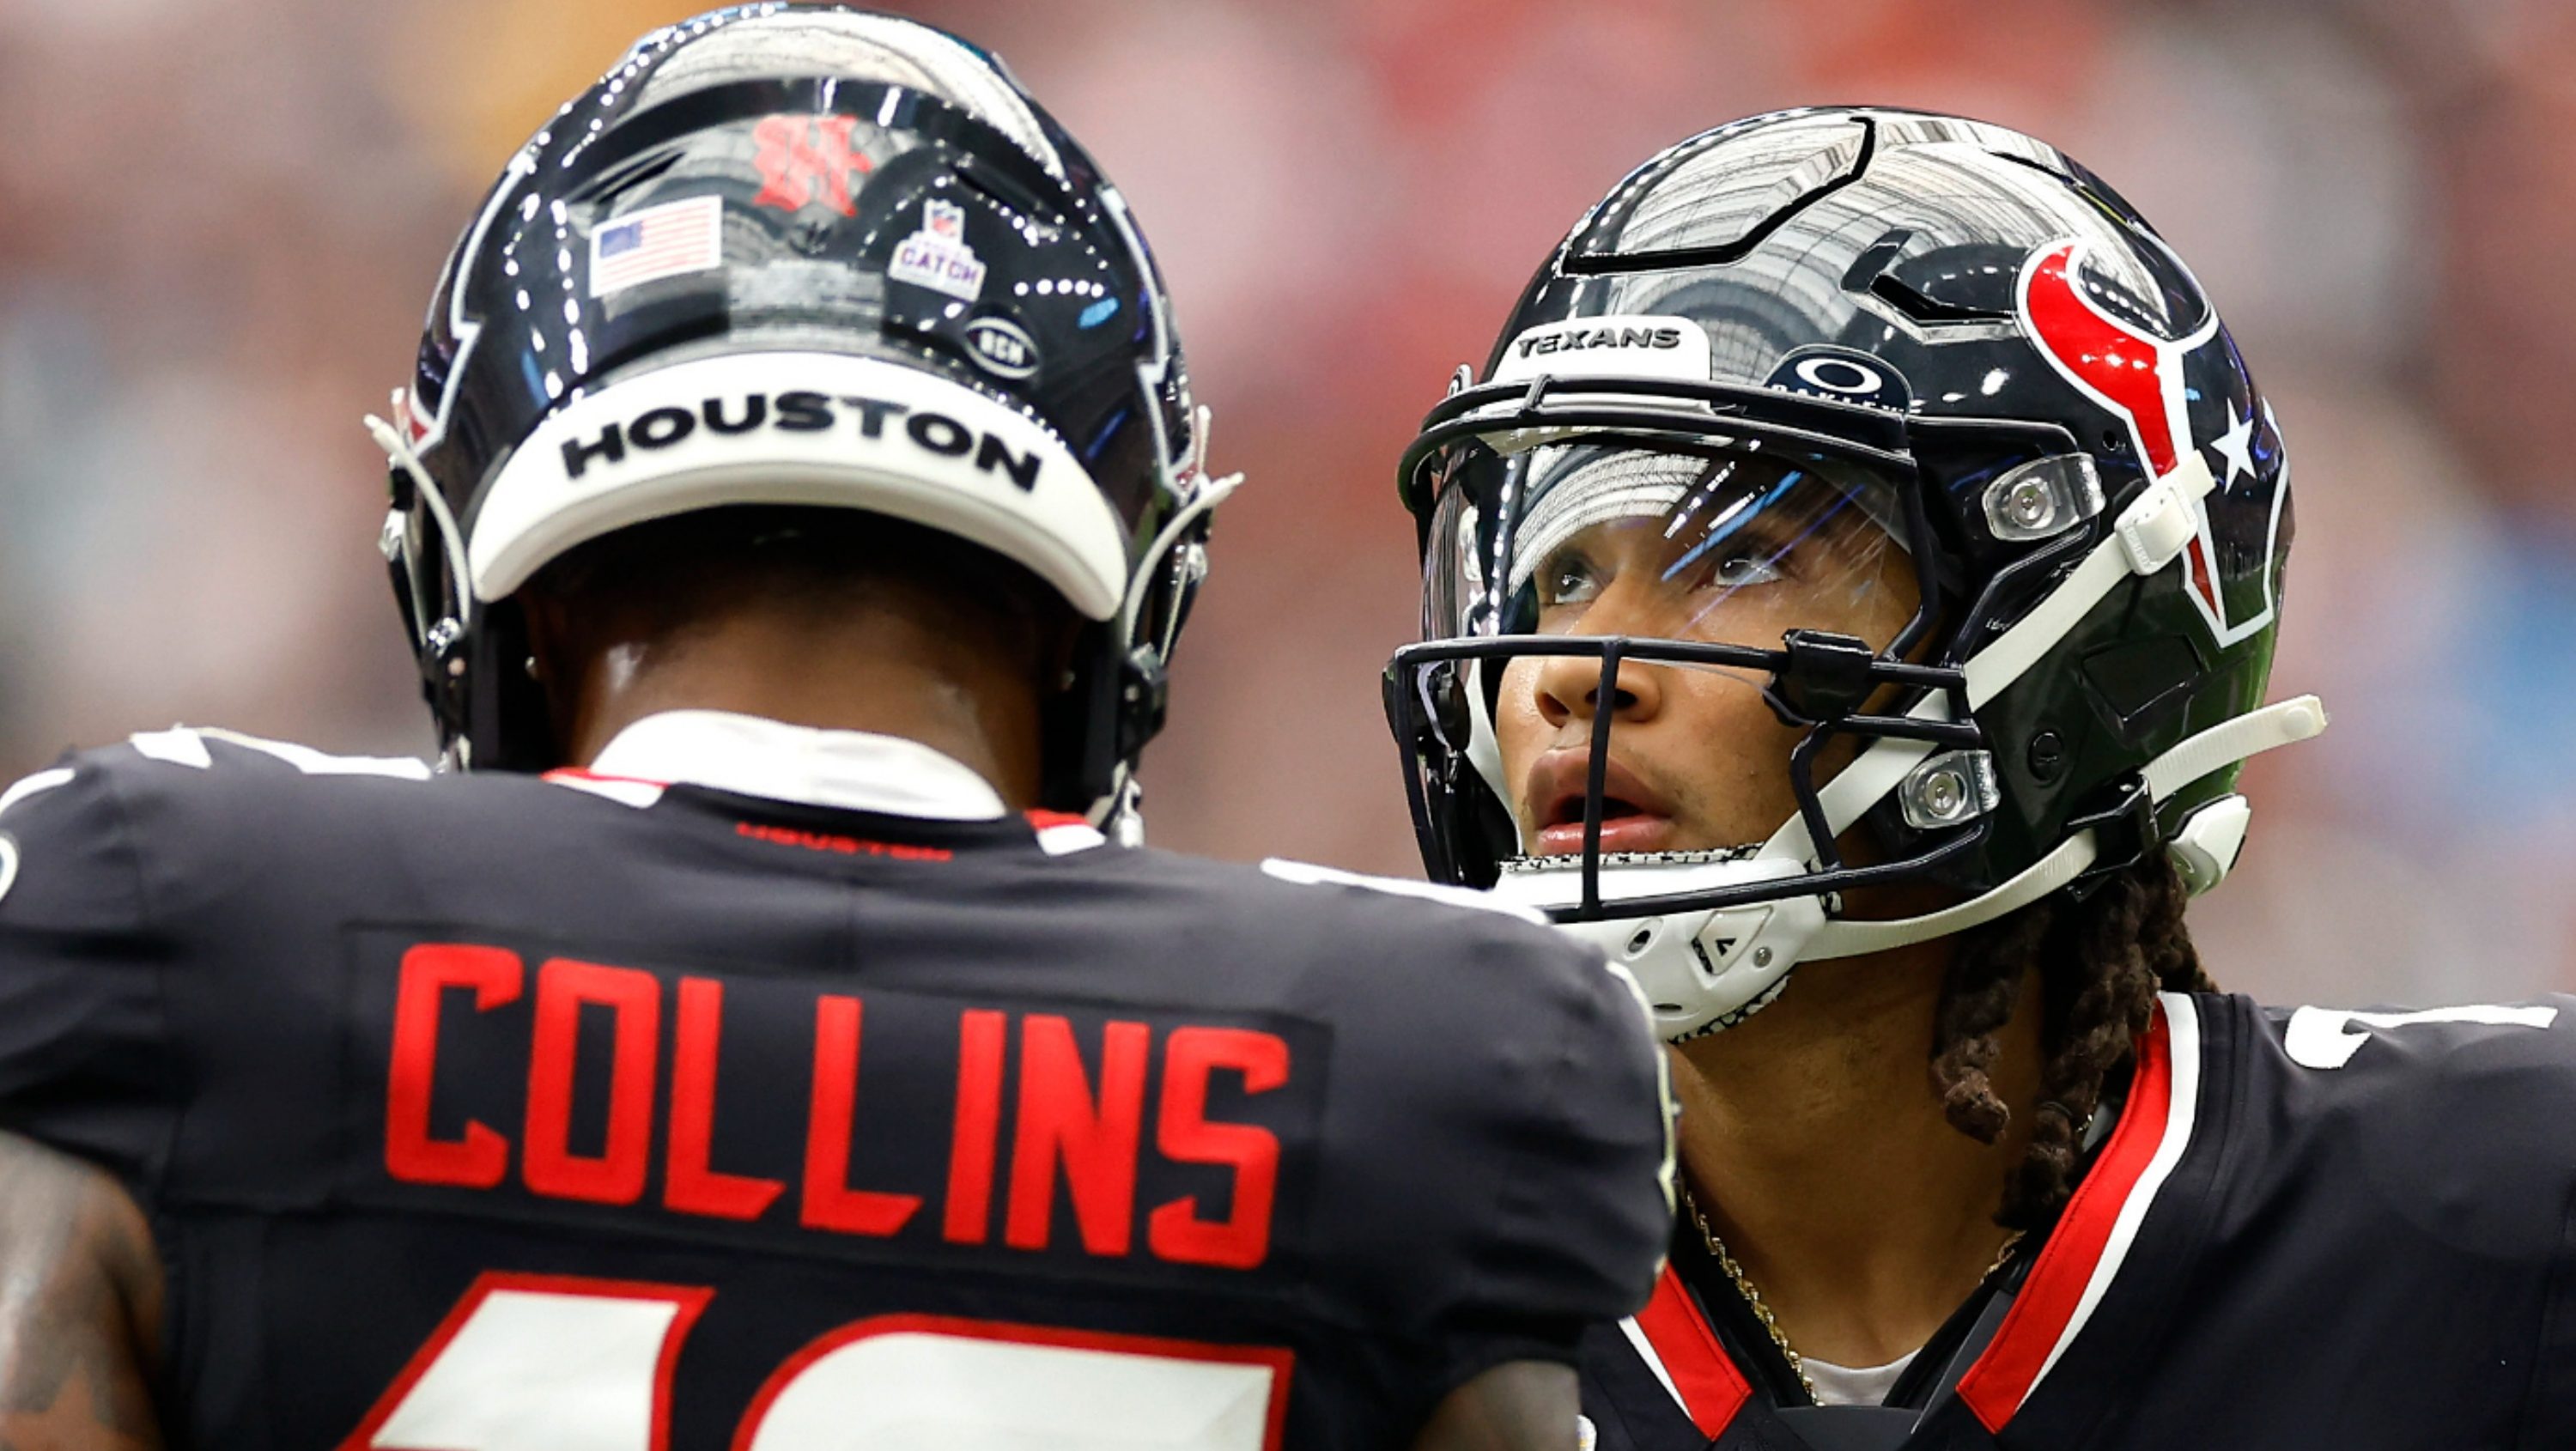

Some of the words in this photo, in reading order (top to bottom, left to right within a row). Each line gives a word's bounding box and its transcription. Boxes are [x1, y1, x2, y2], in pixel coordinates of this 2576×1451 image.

[902, 246, 979, 284] CATCH
[1518, 327, 1681, 360] TEXANS
[561, 391, 1042, 494] HOUSTON
[385, 942, 1290, 1269] COLLINS
